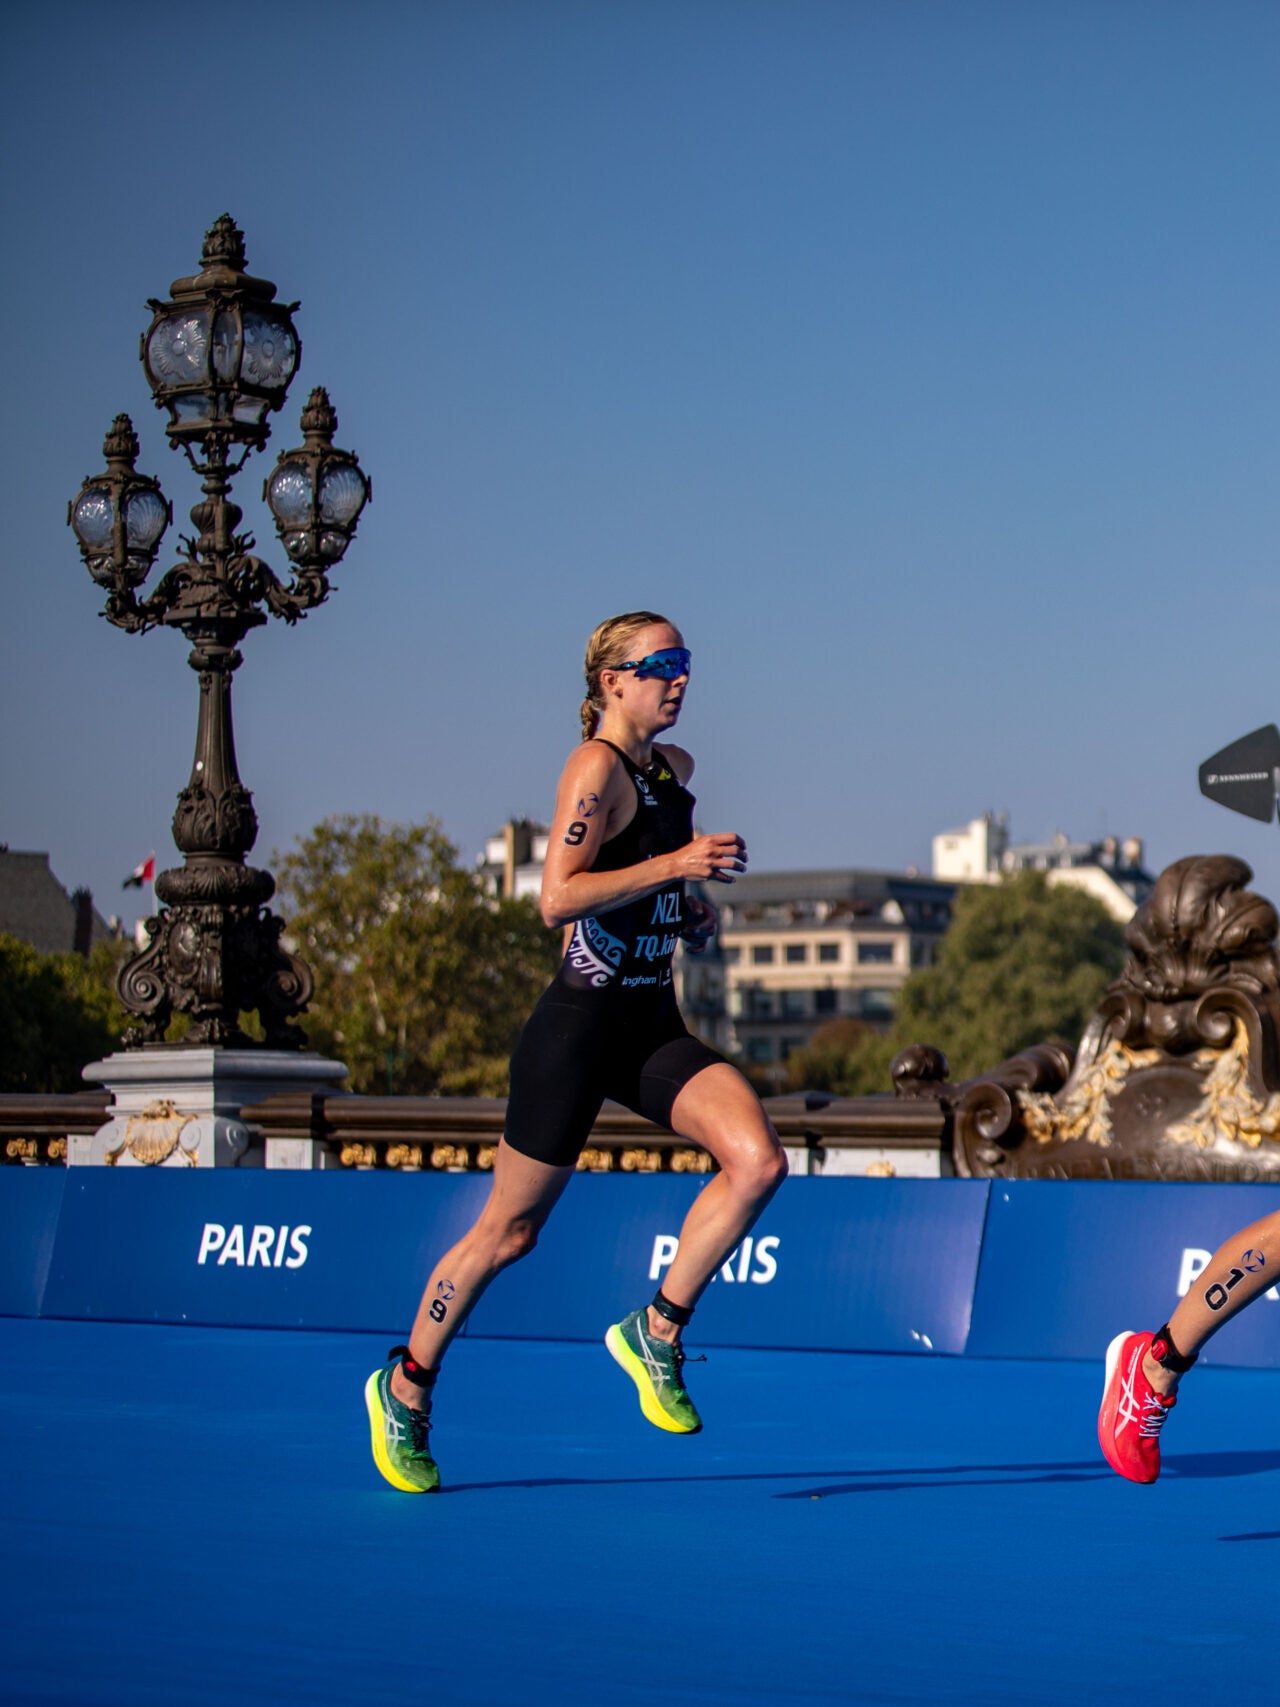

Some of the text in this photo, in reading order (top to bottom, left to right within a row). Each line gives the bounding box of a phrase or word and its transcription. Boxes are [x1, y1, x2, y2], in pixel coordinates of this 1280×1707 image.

[564, 820, 589, 846] 9
[650, 892, 682, 925] NZL
[197, 1223, 313, 1269] PARIS
[649, 1235, 781, 1284] PIS
[1204, 1267, 1247, 1312] 10
[429, 1298, 447, 1324] 9
